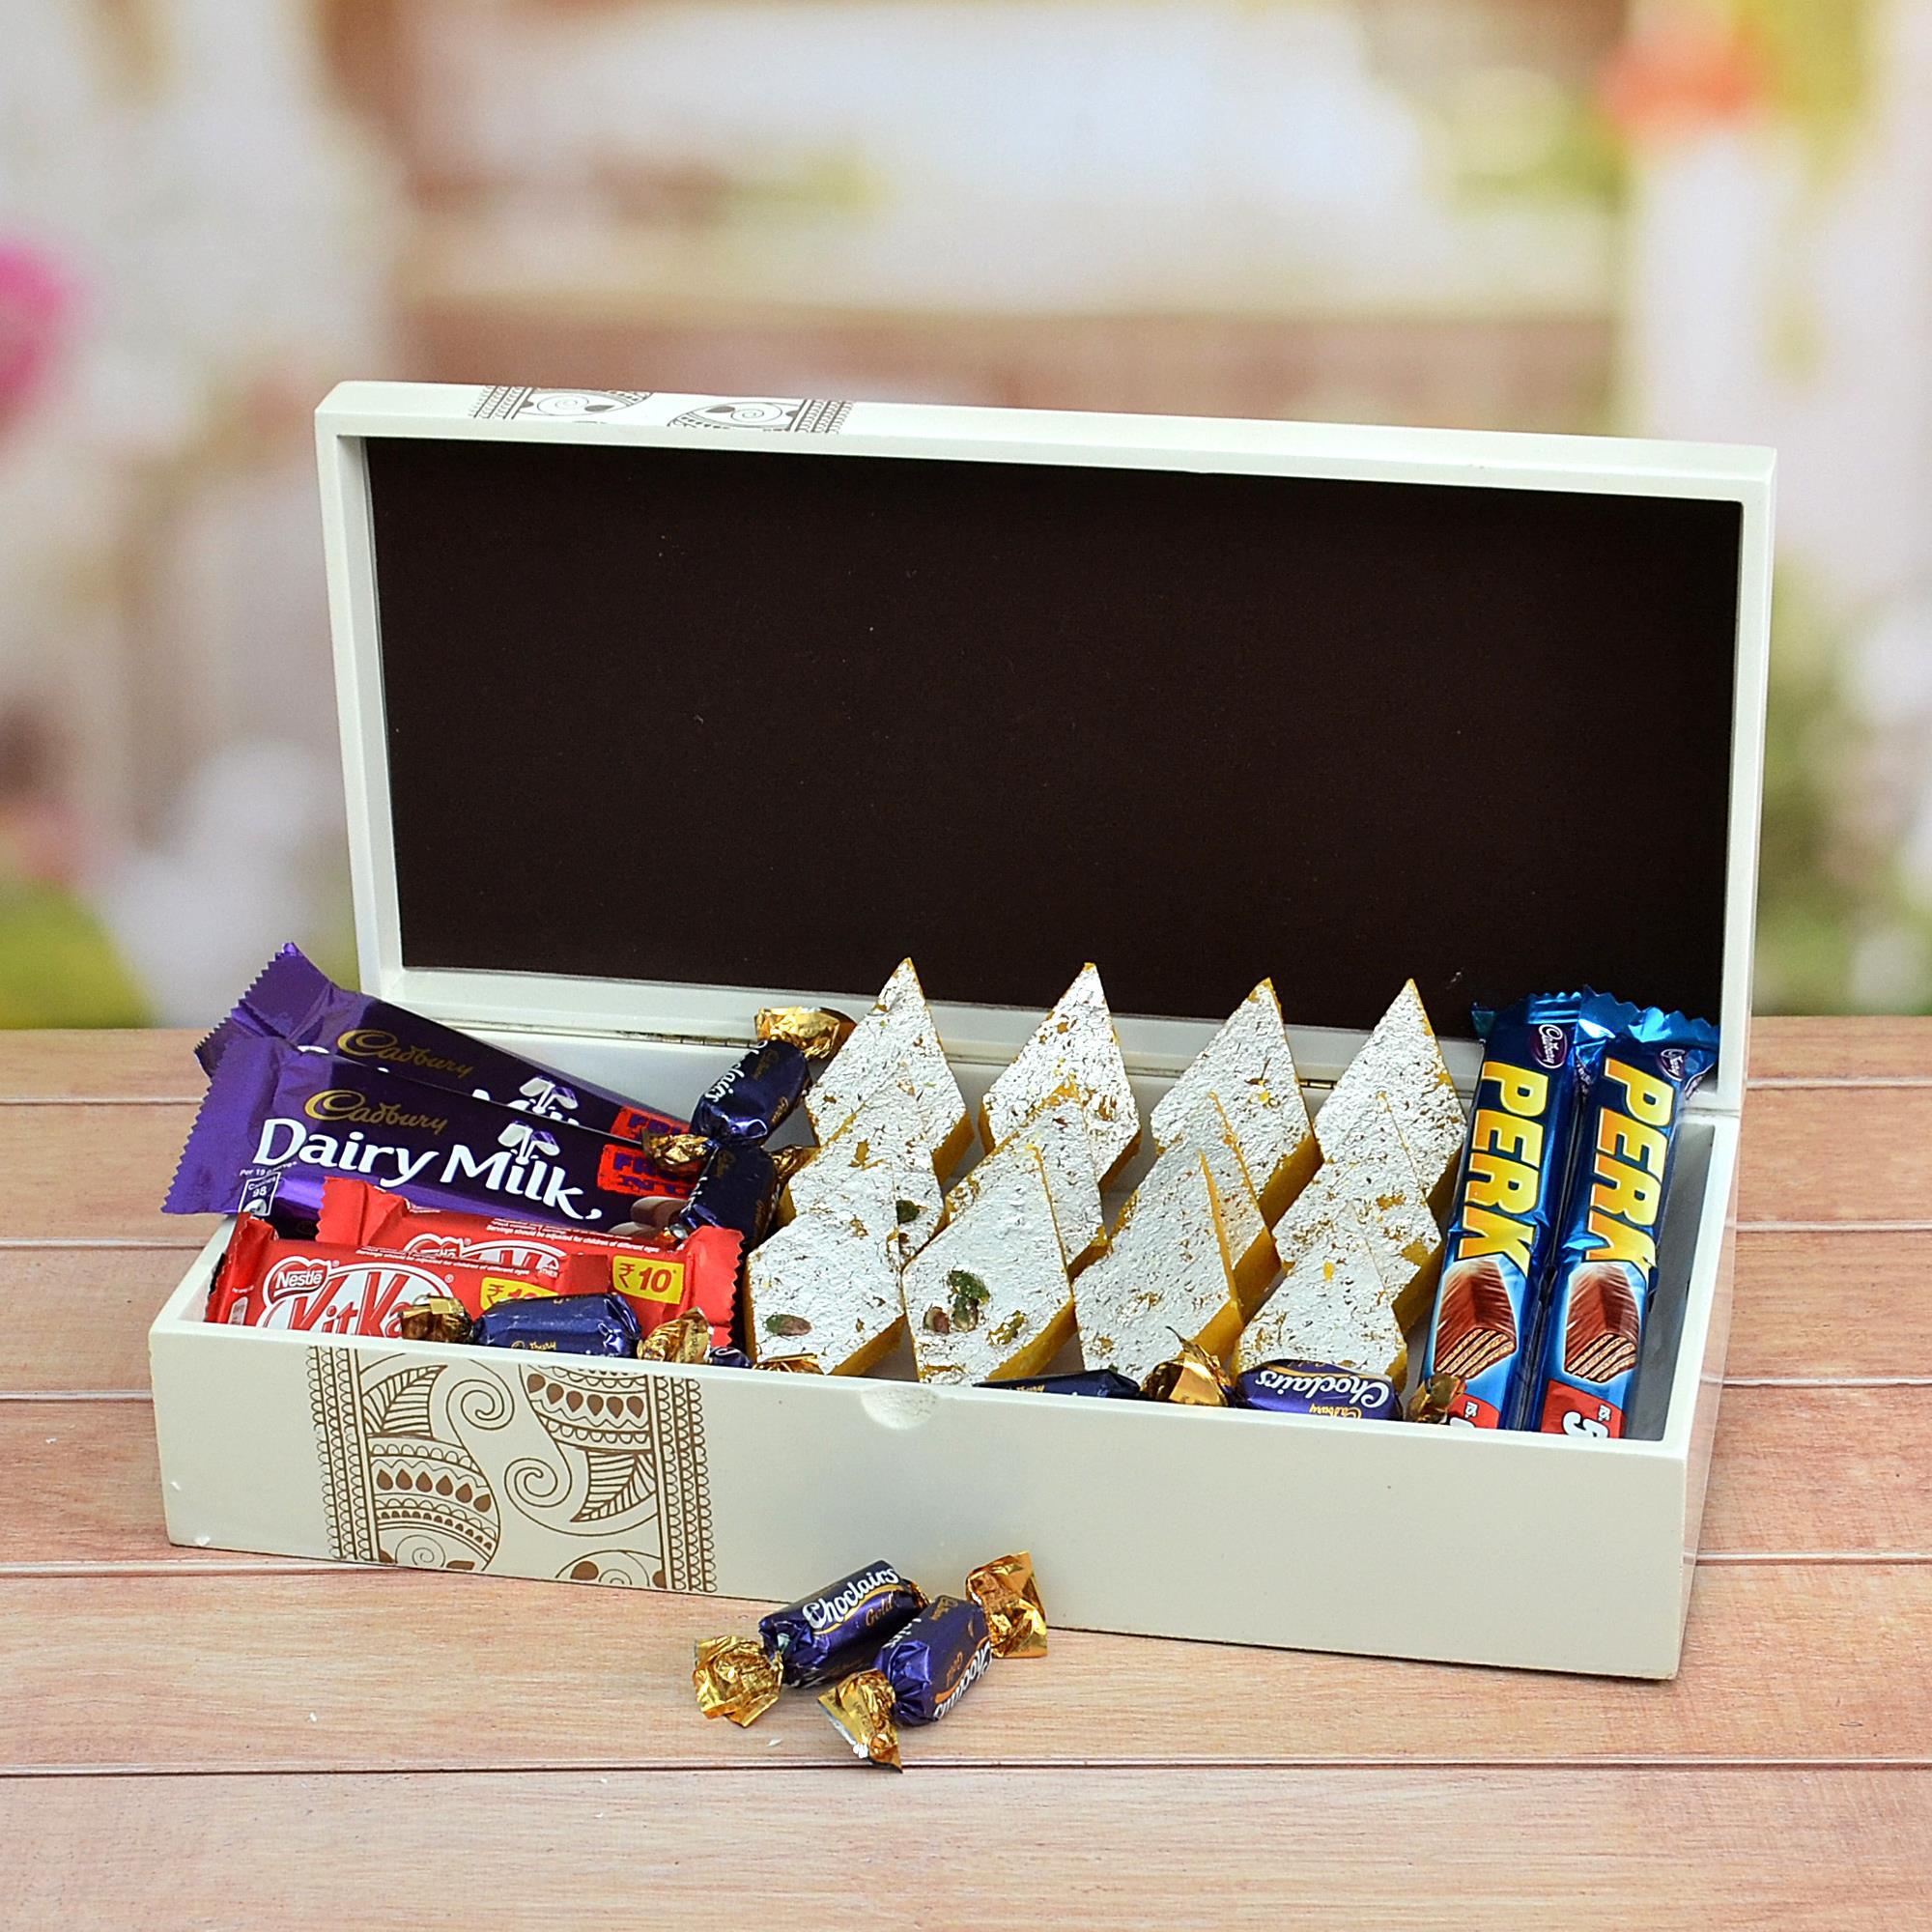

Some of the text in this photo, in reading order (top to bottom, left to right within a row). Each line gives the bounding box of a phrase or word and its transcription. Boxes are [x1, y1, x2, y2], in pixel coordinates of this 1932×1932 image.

[337, 1029, 474, 1078] Cadbury
[305, 1090, 448, 1135] Cadbury
[252, 1118, 440, 1188] Dairy
[440, 1144, 602, 1220] Milk
[1458, 1061, 1548, 1278] PERK
[1585, 1057, 1675, 1276] PERK
[1254, 1369, 1390, 1408] Choclairs
[802, 1567, 899, 1630] Choclairs
[865, 1591, 895, 1628] Gold
